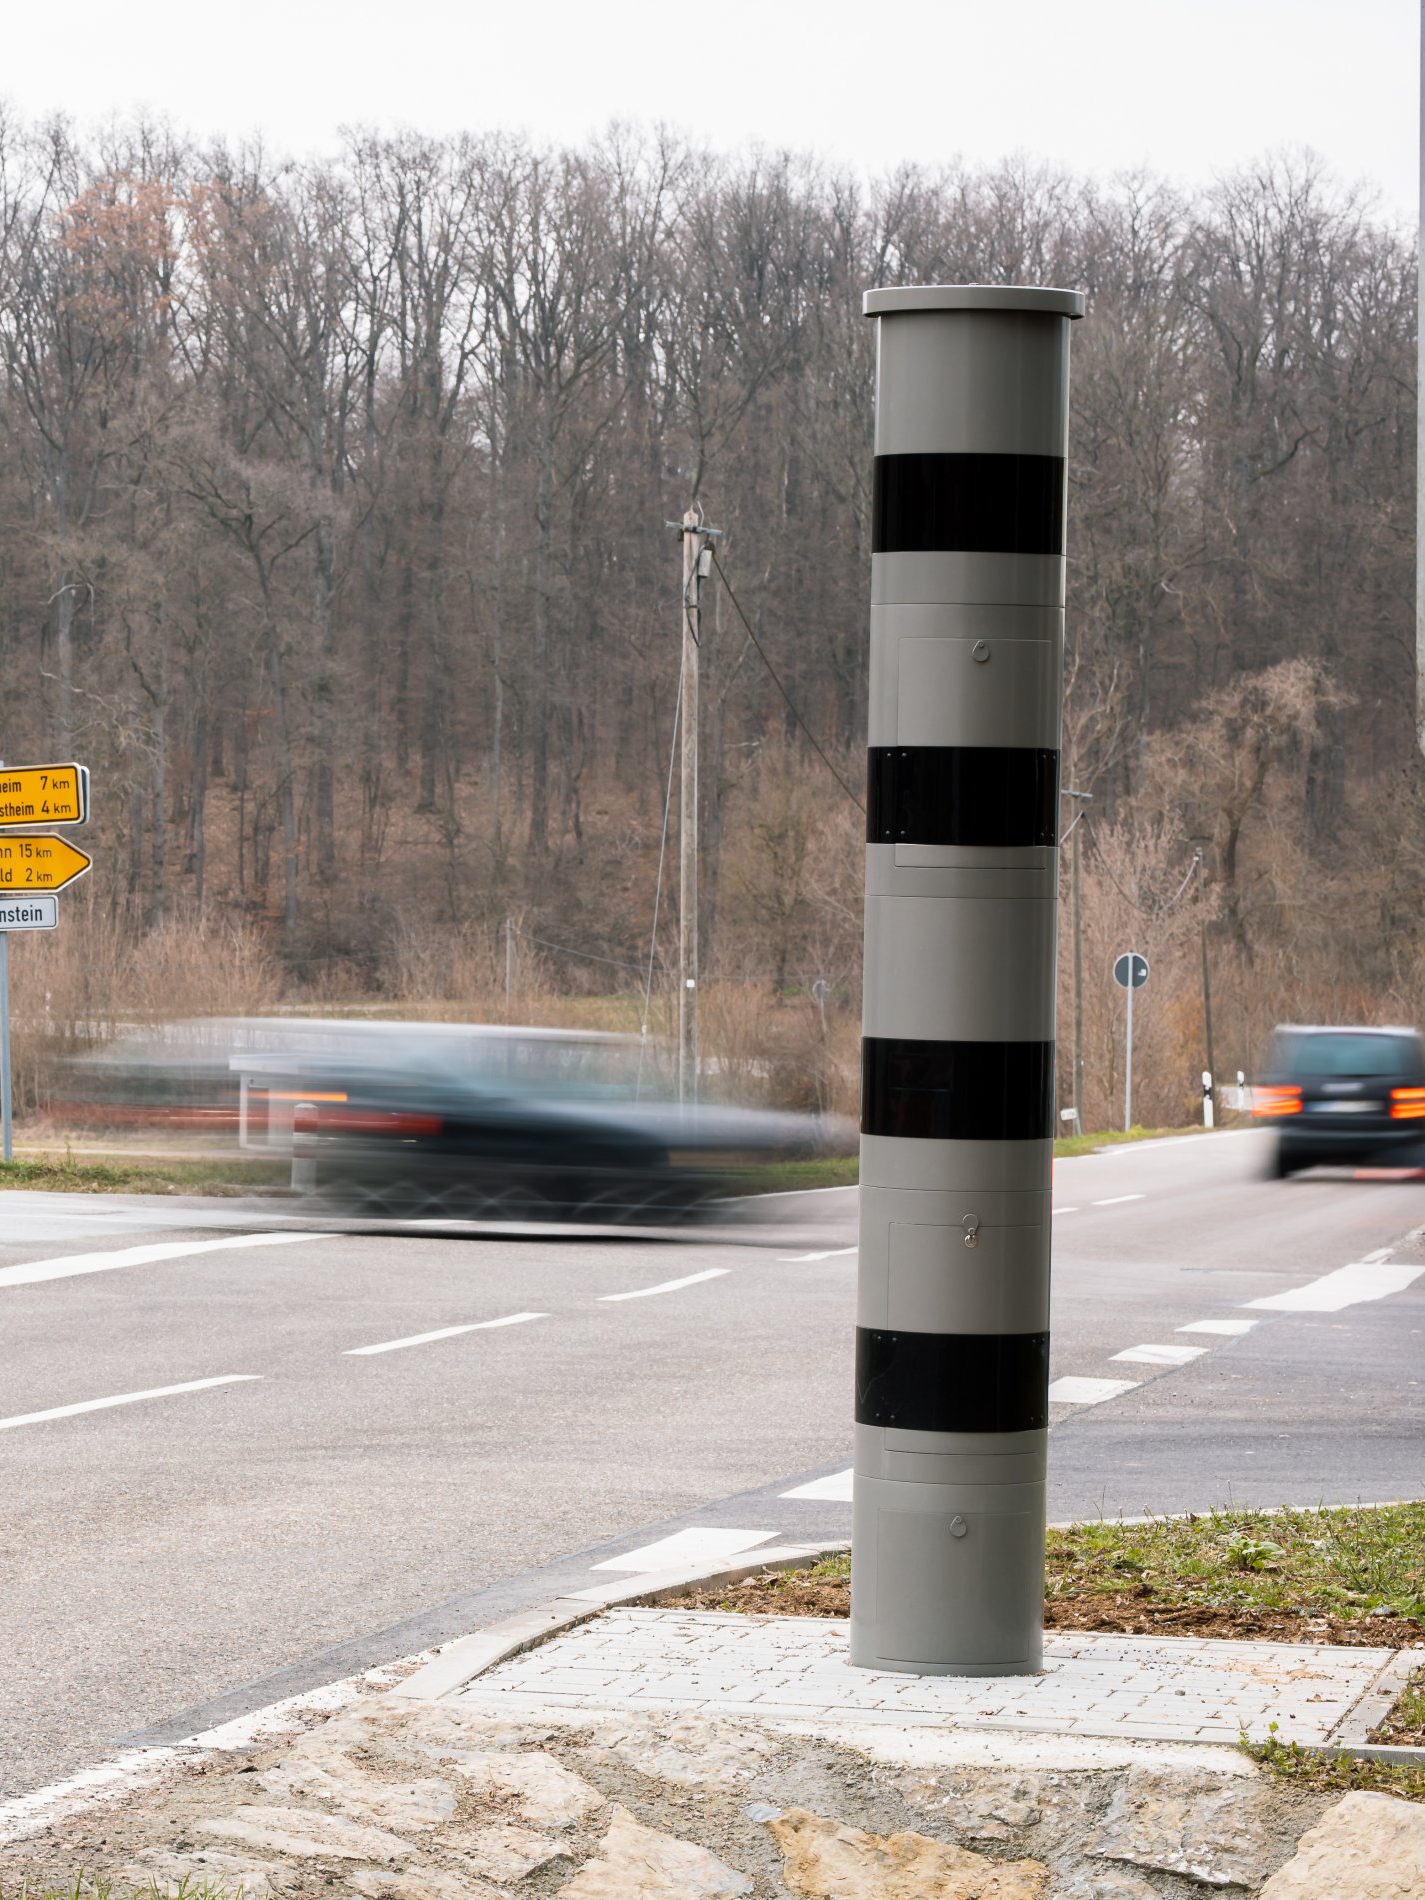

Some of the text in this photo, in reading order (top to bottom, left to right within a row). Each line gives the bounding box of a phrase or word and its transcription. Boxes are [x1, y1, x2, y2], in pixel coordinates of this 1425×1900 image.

[40, 776, 48, 791] 7
[52, 778, 70, 790] km
[41, 800, 50, 815] 4
[53, 802, 71, 814] km
[19, 843, 33, 858] 15
[35, 847, 52, 858] km
[25, 868, 33, 882] 2
[36, 871, 53, 882] km
